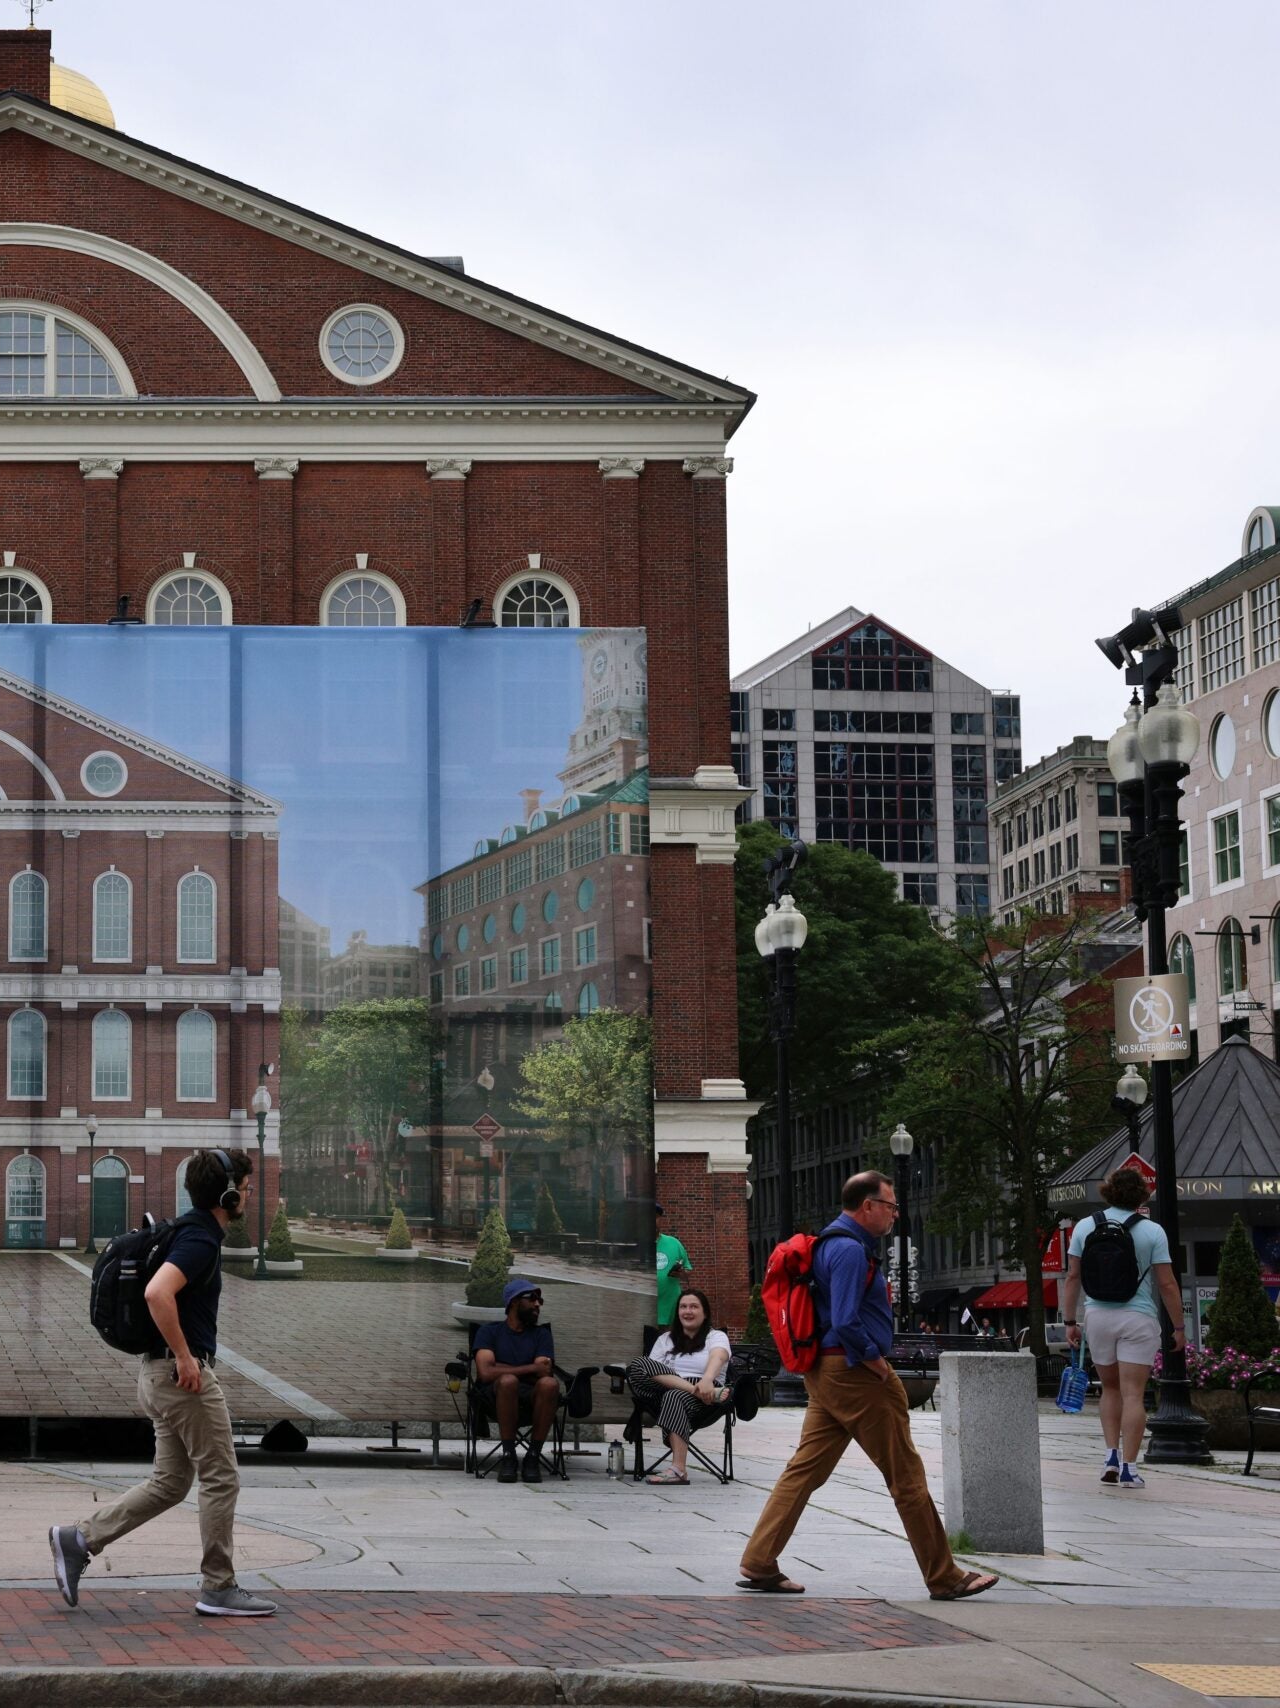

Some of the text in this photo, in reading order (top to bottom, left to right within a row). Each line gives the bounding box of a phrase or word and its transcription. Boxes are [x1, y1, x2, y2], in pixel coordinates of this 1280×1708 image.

[1119, 1045, 1129, 1054] NO
[1130, 1041, 1188, 1053] SKATEBOARDING
[1176, 1180, 1222, 1195] STON
[1199, 1289, 1218, 1298] Ope
